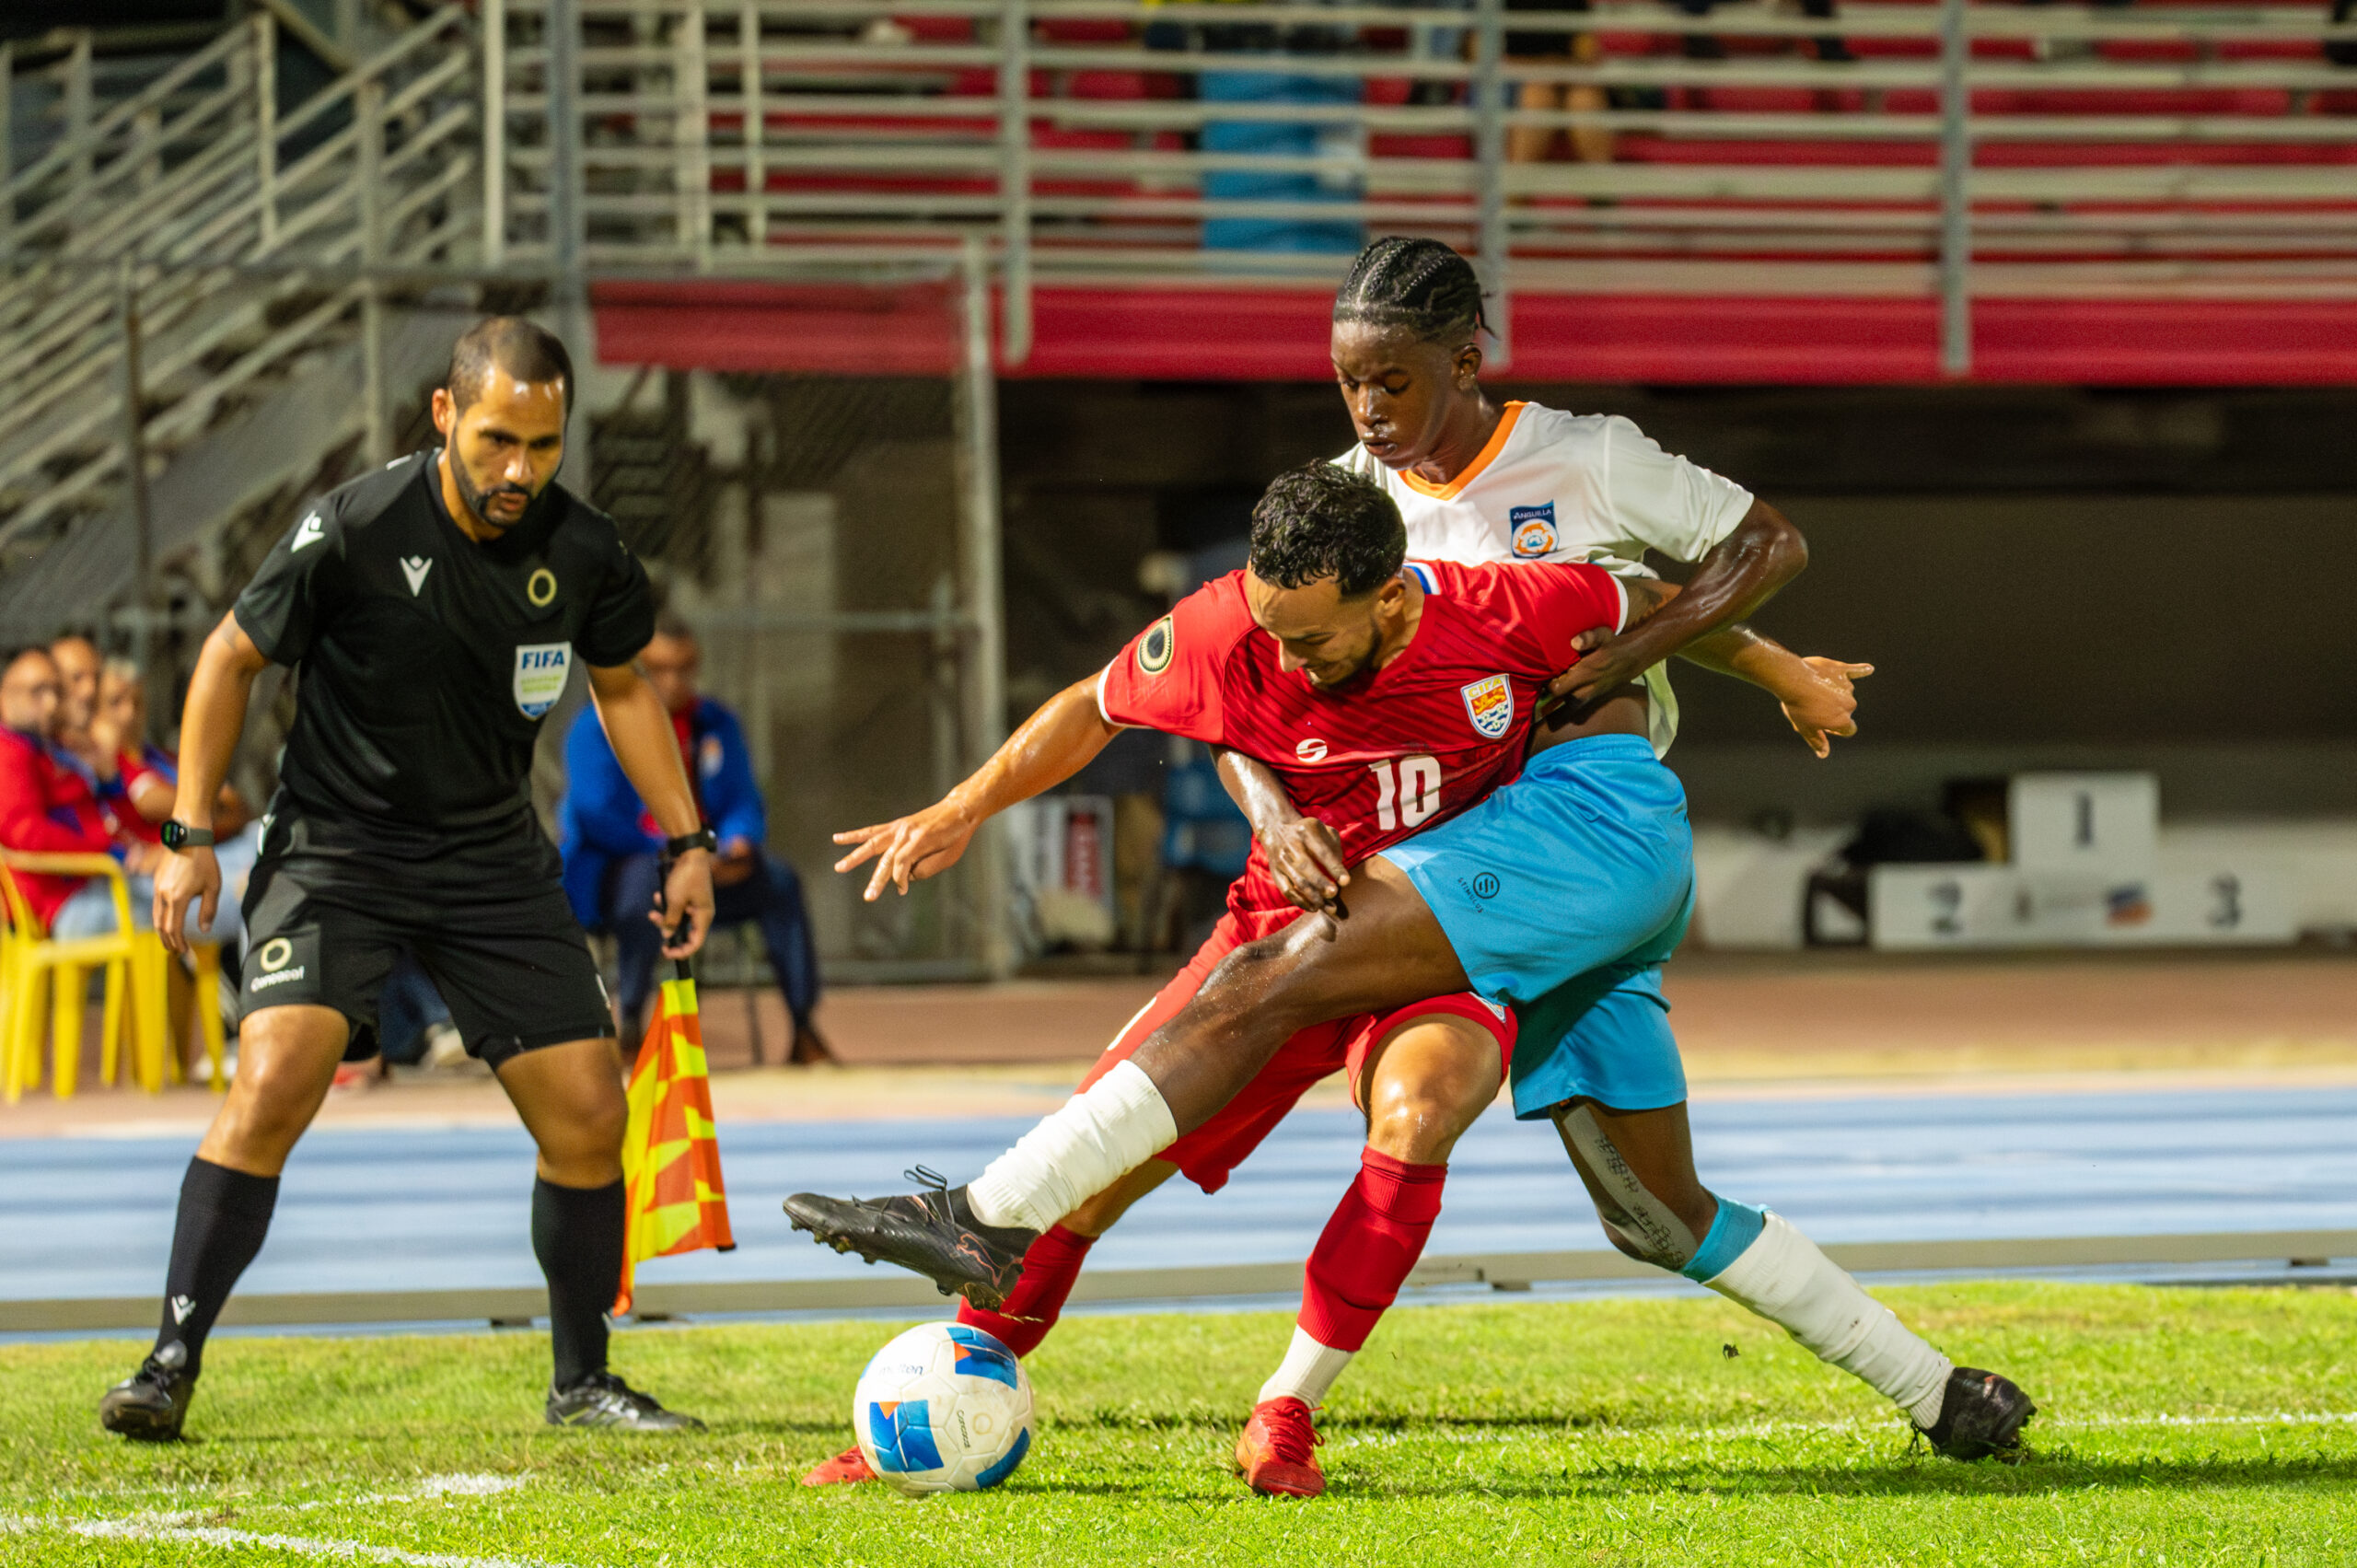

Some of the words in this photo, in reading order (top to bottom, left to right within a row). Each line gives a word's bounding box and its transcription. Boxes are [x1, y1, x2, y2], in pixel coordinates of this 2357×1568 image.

[1514, 508, 1552, 519] ANGUILLA
[521, 649, 565, 670] FIFA
[1468, 677, 1503, 698] CIFA
[1367, 754, 1442, 830] 10
[2074, 790, 2094, 848] 1
